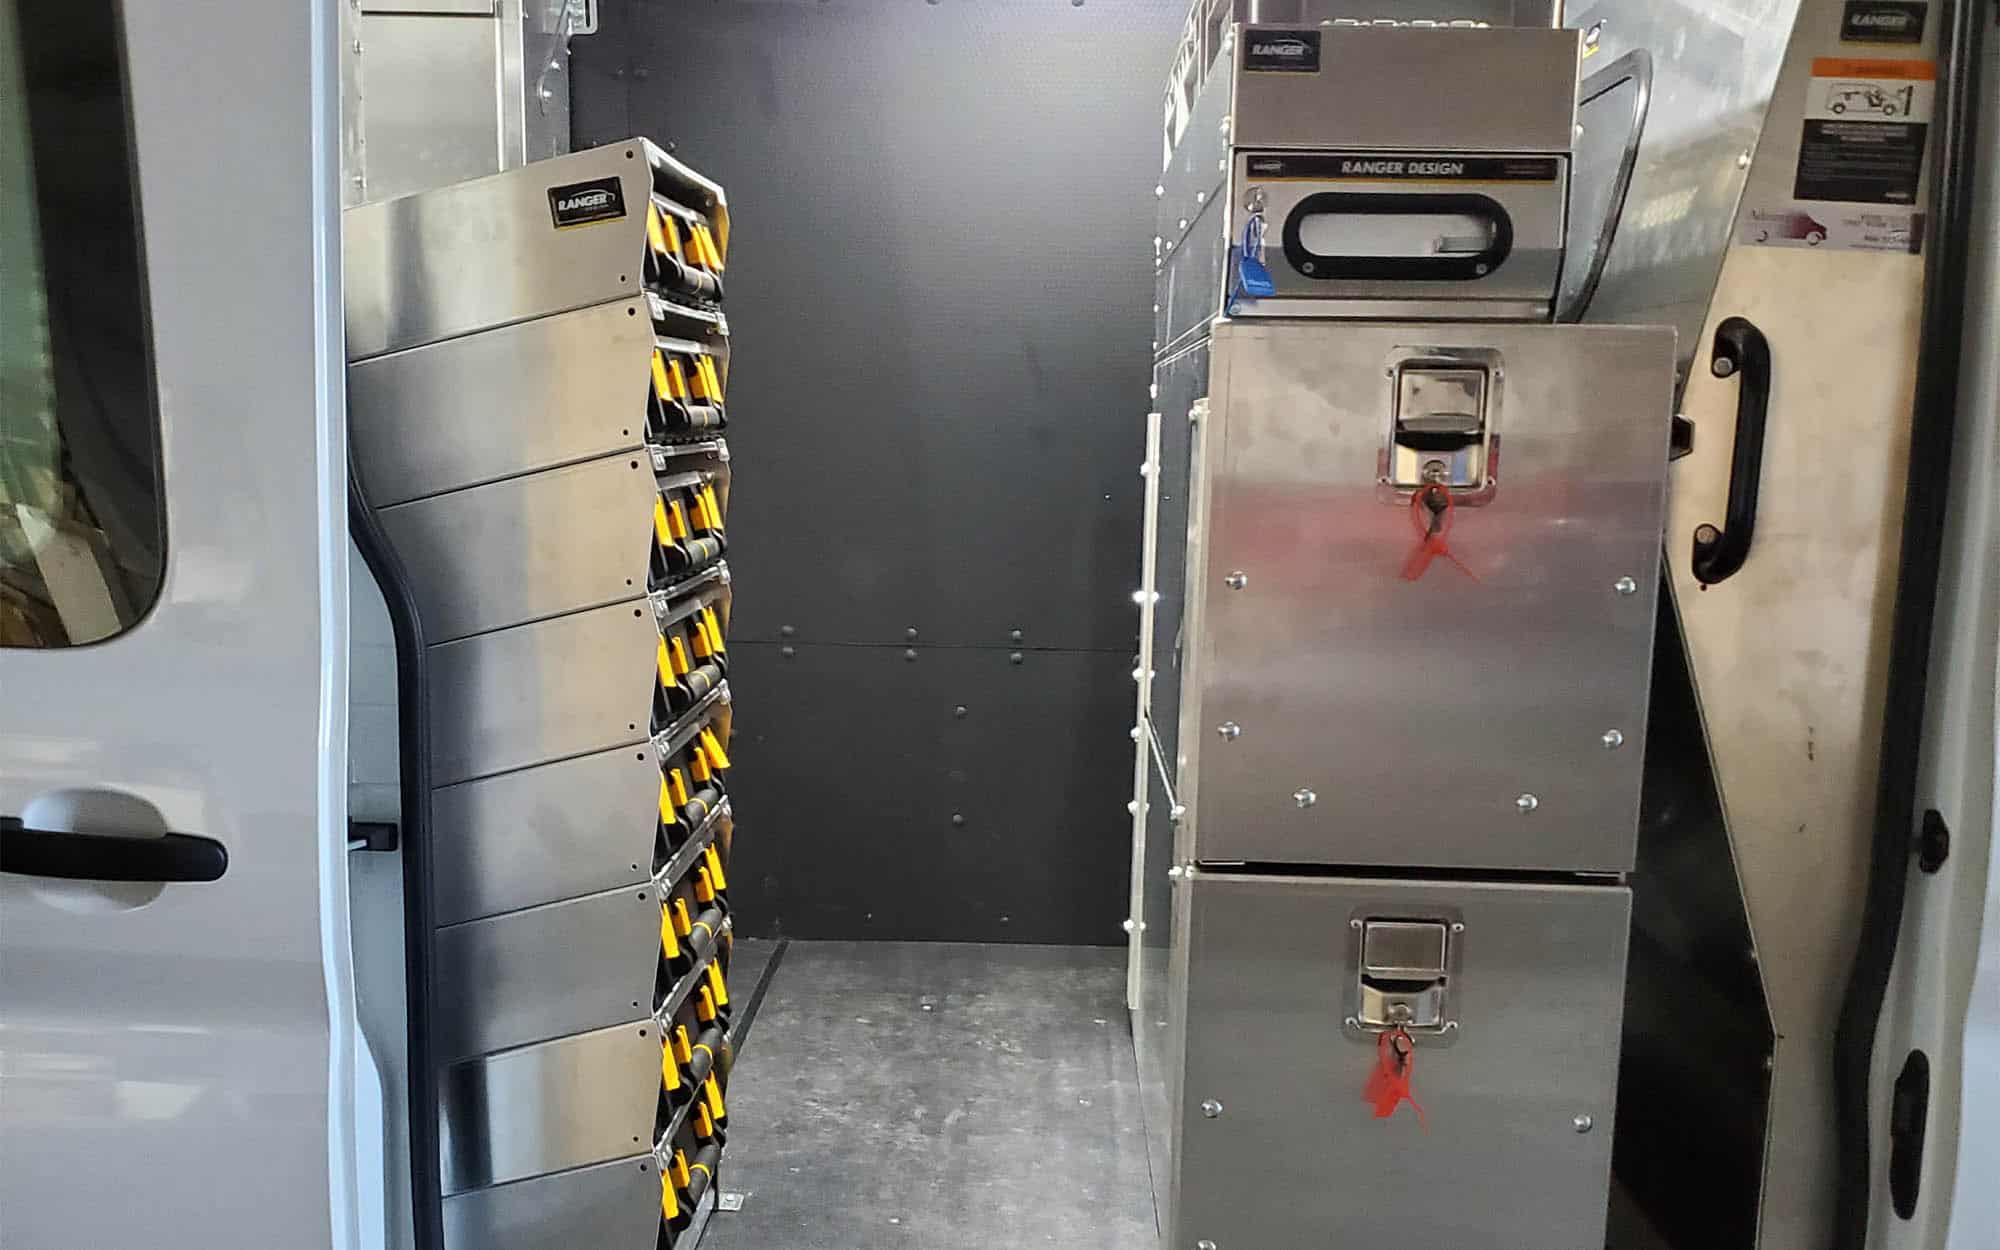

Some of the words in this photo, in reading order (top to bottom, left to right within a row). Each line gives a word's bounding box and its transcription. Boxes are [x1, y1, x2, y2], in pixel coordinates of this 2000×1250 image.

[1252, 44, 1304, 56] RANGER
[1341, 161, 1404, 175] RANGER
[1407, 162, 1464, 175] DESIGN
[558, 193, 608, 211] RANGER
